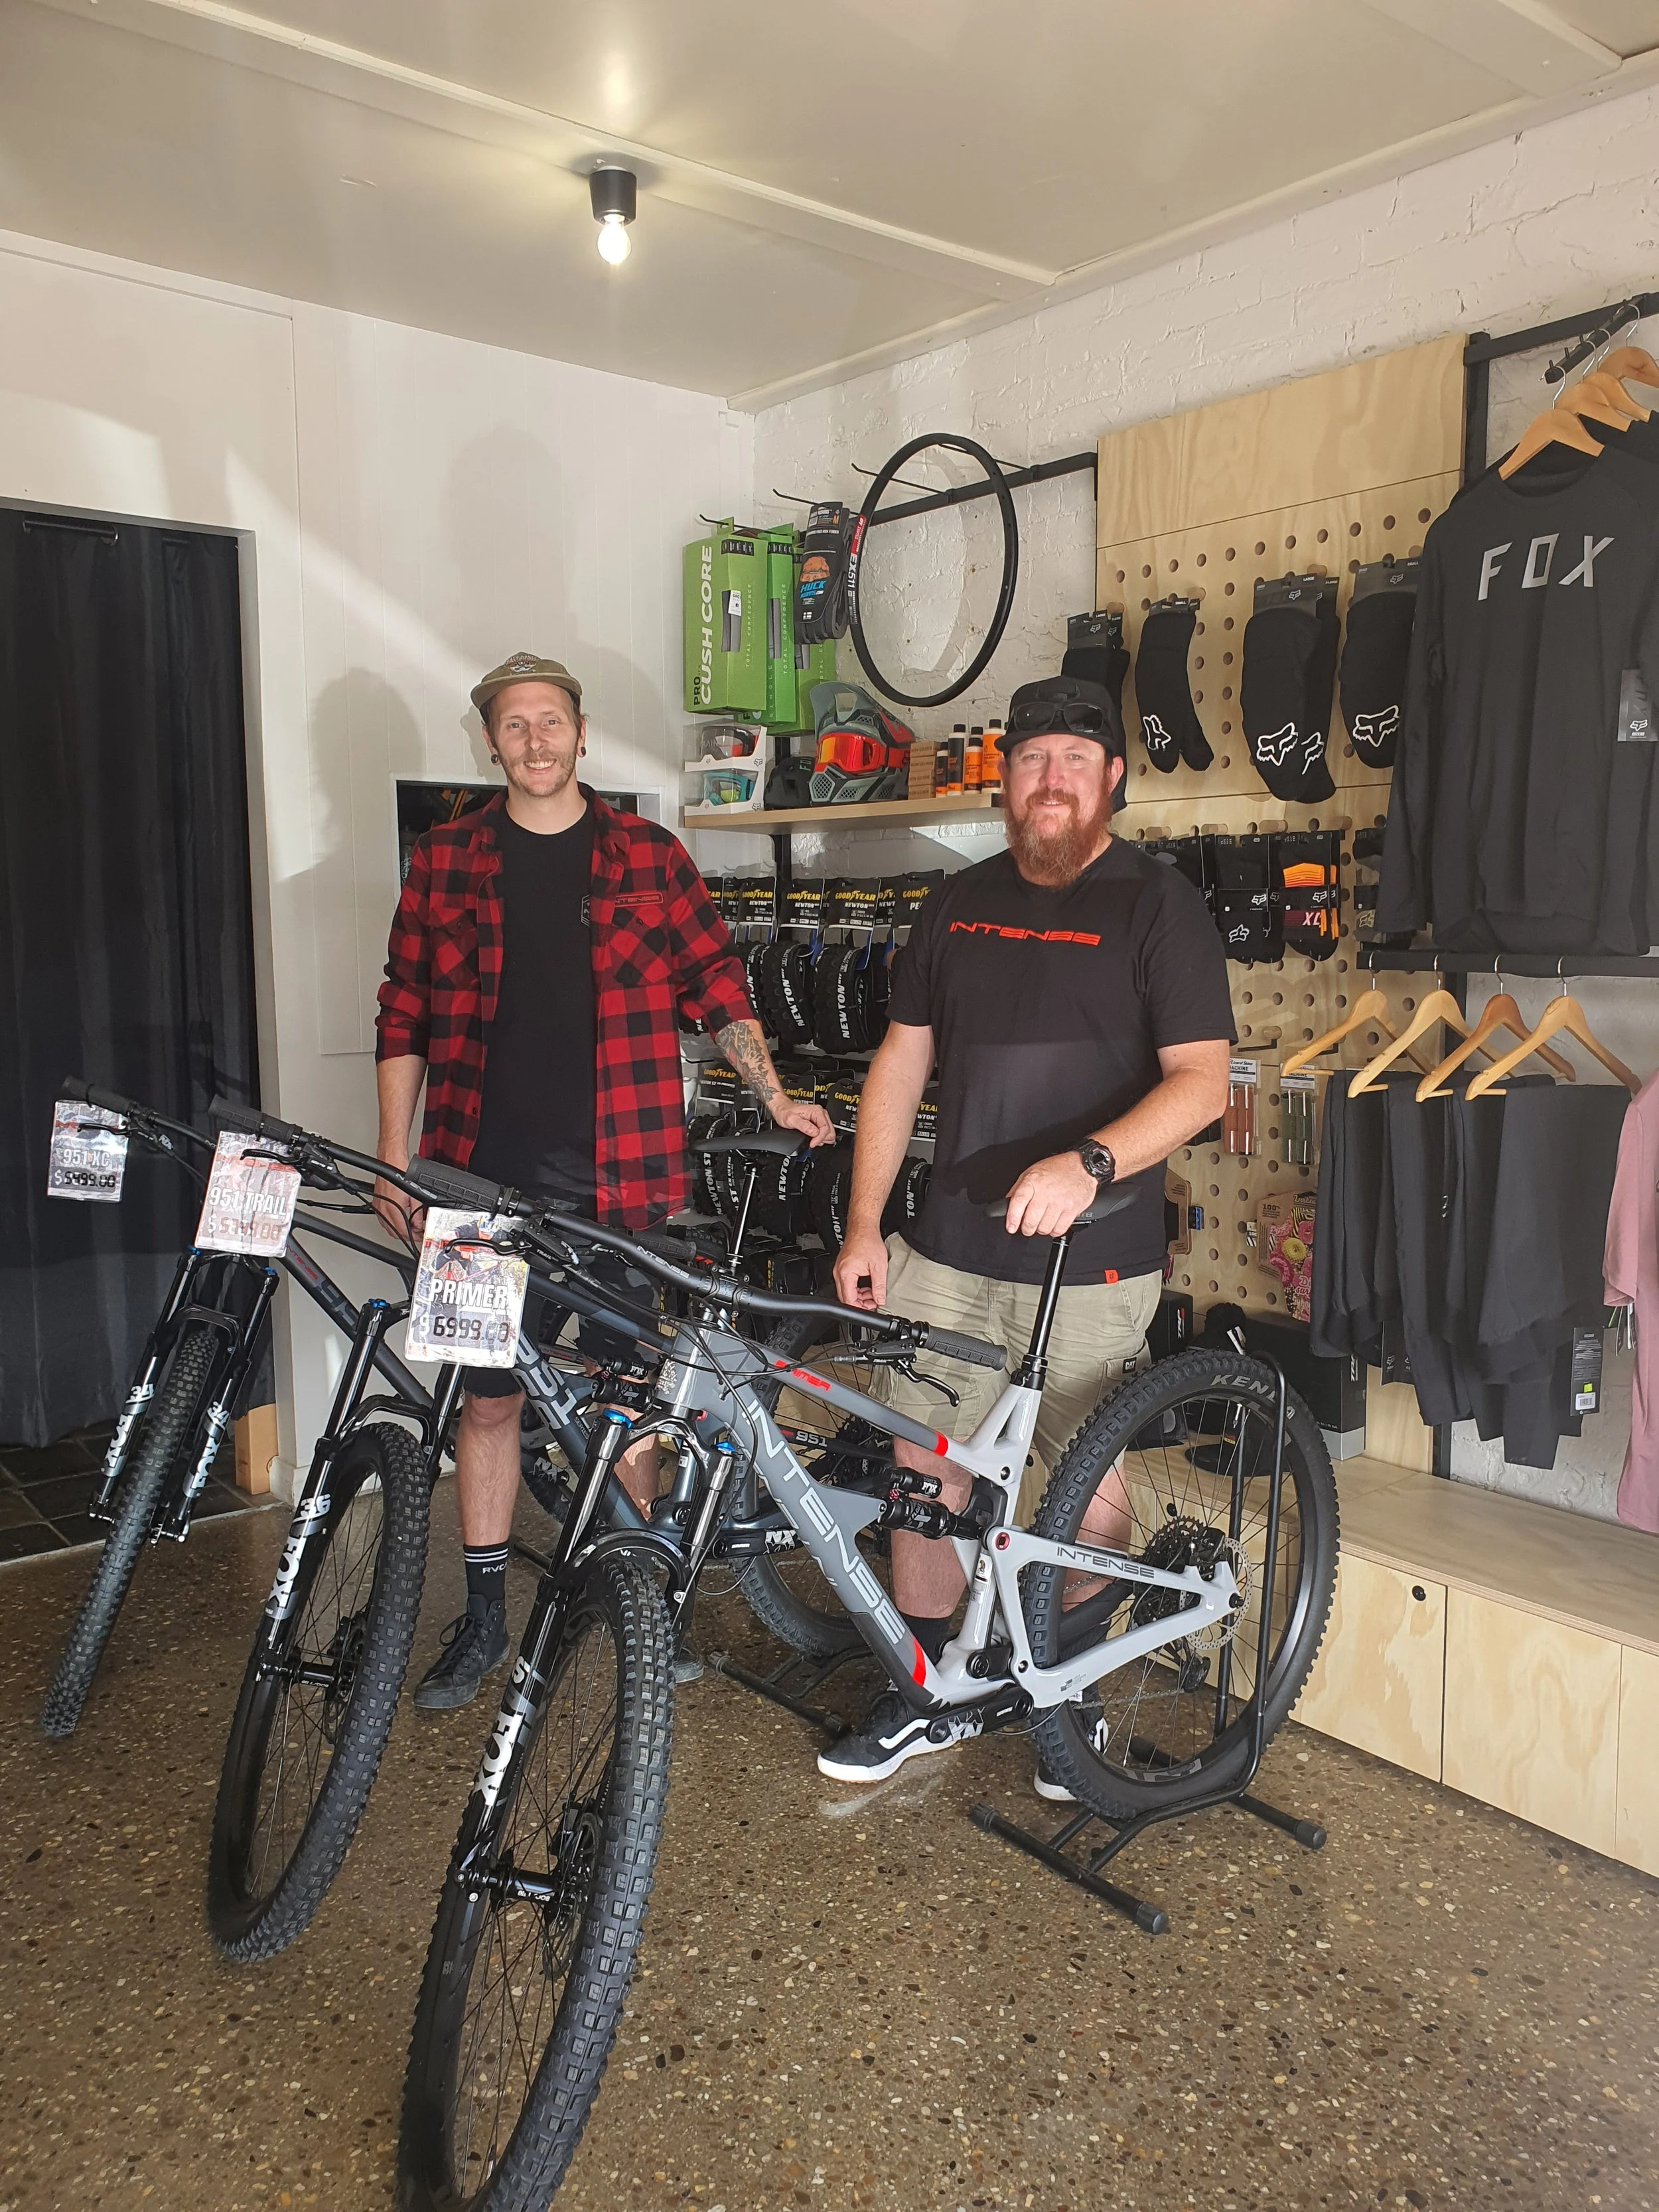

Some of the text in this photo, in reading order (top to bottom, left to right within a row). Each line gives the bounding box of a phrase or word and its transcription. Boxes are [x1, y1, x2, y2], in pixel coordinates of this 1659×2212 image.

[847, 553, 857, 589] EX511
[1478, 533, 1615, 601] FOX
[800, 580, 826, 593] HUCK
[701, 546, 713, 705] CUSH CORE
[799, 758, 812, 771] FO
[742, 889, 773, 899] GOODYEAR
[786, 890, 821, 901] GOODYEAR
[835, 890, 877, 901] GOODYEAR
[902, 886, 930, 899] GOODY
[949, 921, 1102, 946] INTENSE
[782, 979, 806, 1027] NEWTON
[837, 984, 851, 1039] NEWTON
[703, 1069, 737, 1078] GOODYEAR
[834, 1092, 861, 1104] GOODY
[63, 1148, 111, 1167] 951 XC
[54, 1169, 62, 1185] $
[209, 1187, 287, 1216] 951 TRAIL
[704, 1168, 724, 1215] NEWTON
[906, 1190, 915, 1218] TON
[536, 1248, 552, 1260] TRAIL
[636, 1244, 690, 1280] INTENSE
[431, 1278, 509, 1310] PRIMER
[630, 1365, 644, 1376] FOX
[774, 1359, 831, 1392] PIMER
[1125, 1360, 1135, 1369] CAT
[131, 1382, 155, 1400] 34
[207, 1400, 230, 1426] 34
[574, 1416, 590, 1440] SERIES
[796, 1430, 828, 1447] 951
[104, 1414, 133, 1469] FOX
[191, 1437, 221, 1489] FOX
[921, 1481, 938, 1495] FOX
[301, 1493, 331, 1516] 36
[741, 1398, 906, 1645] INTENSE
[762, 1529, 798, 1554] NX
[267, 1536, 307, 1609] FOX
[1055, 1545, 1155, 1580] INTENSE
[472, 1710, 526, 1806] FOX
